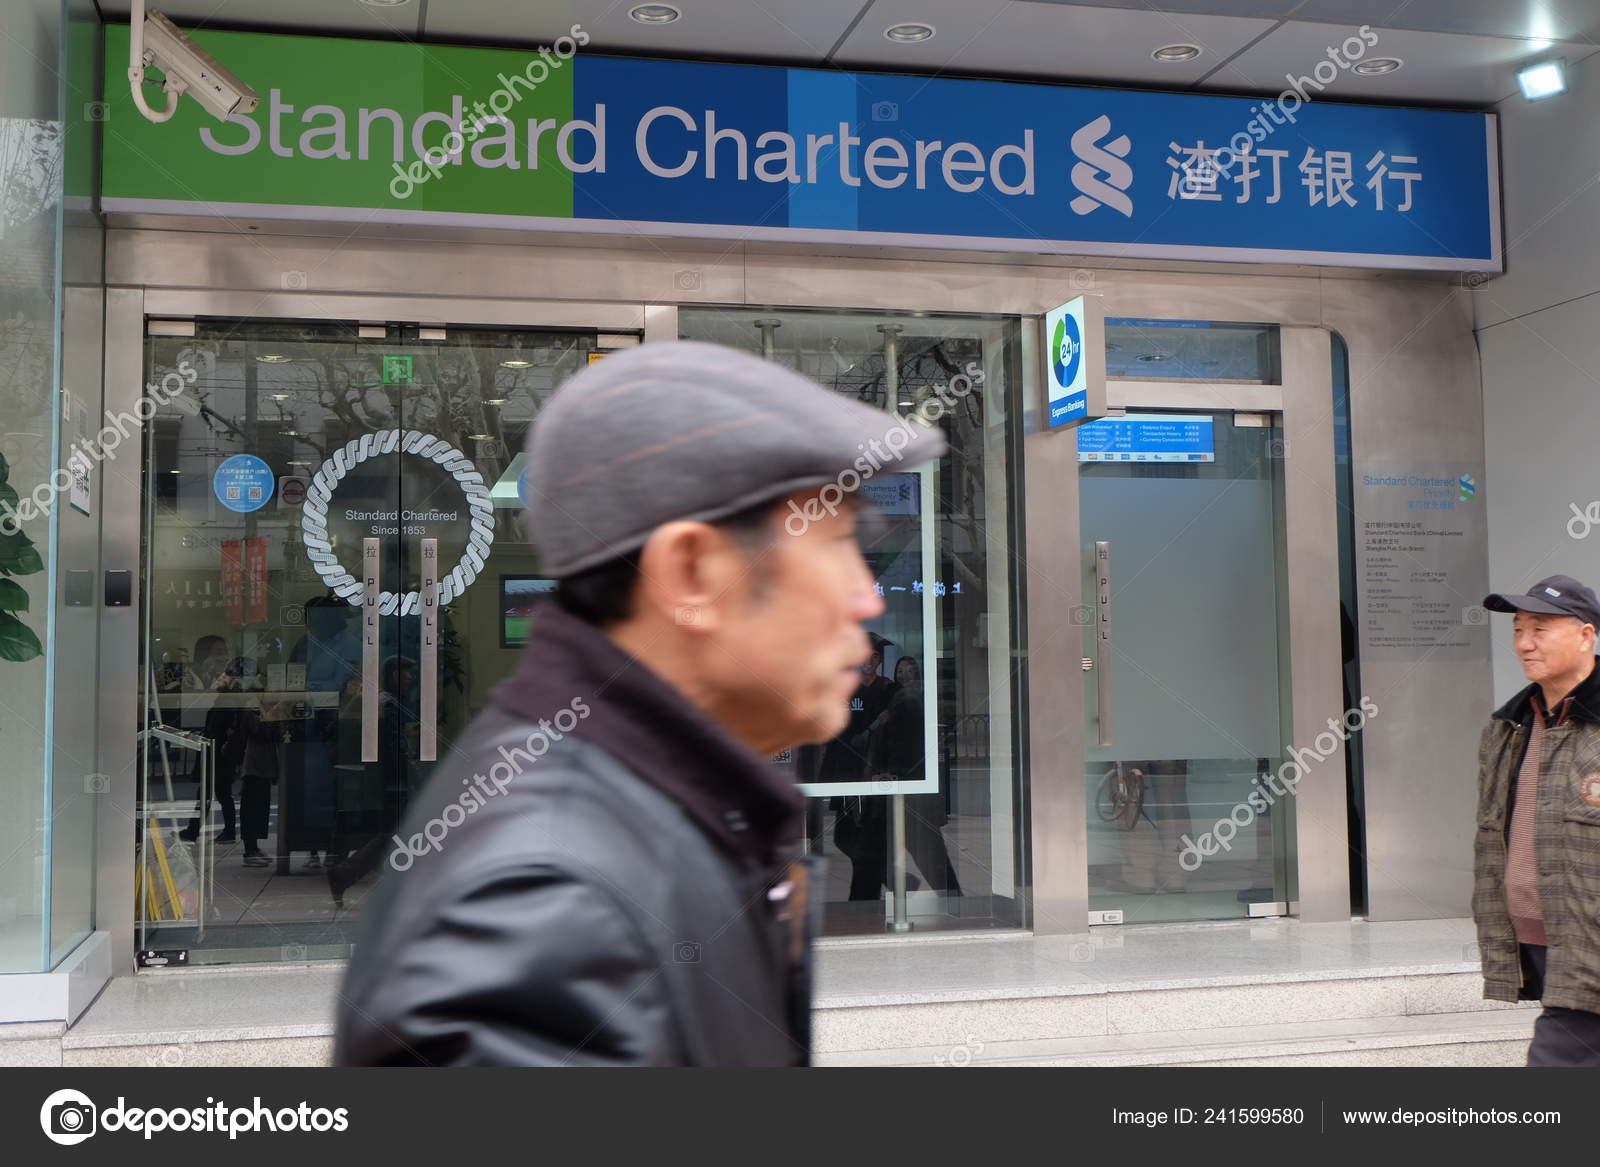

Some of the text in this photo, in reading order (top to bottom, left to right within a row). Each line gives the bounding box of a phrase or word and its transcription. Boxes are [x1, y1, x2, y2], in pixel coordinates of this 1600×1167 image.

[198, 88, 1035, 197] Standard Chartered
[1165, 139, 1423, 213] 渣打银行
[1363, 475, 1456, 488] Standard Chartered
[345, 510, 457, 521] Standard Chartered
[371, 525, 426, 536] Since 1853
[366, 545, 377, 558] 拉
[424, 546, 435, 559] 拉
[367, 577, 375, 646] PULL
[425, 578, 433, 646] PULL
[1100, 577, 1108, 640] PULL
